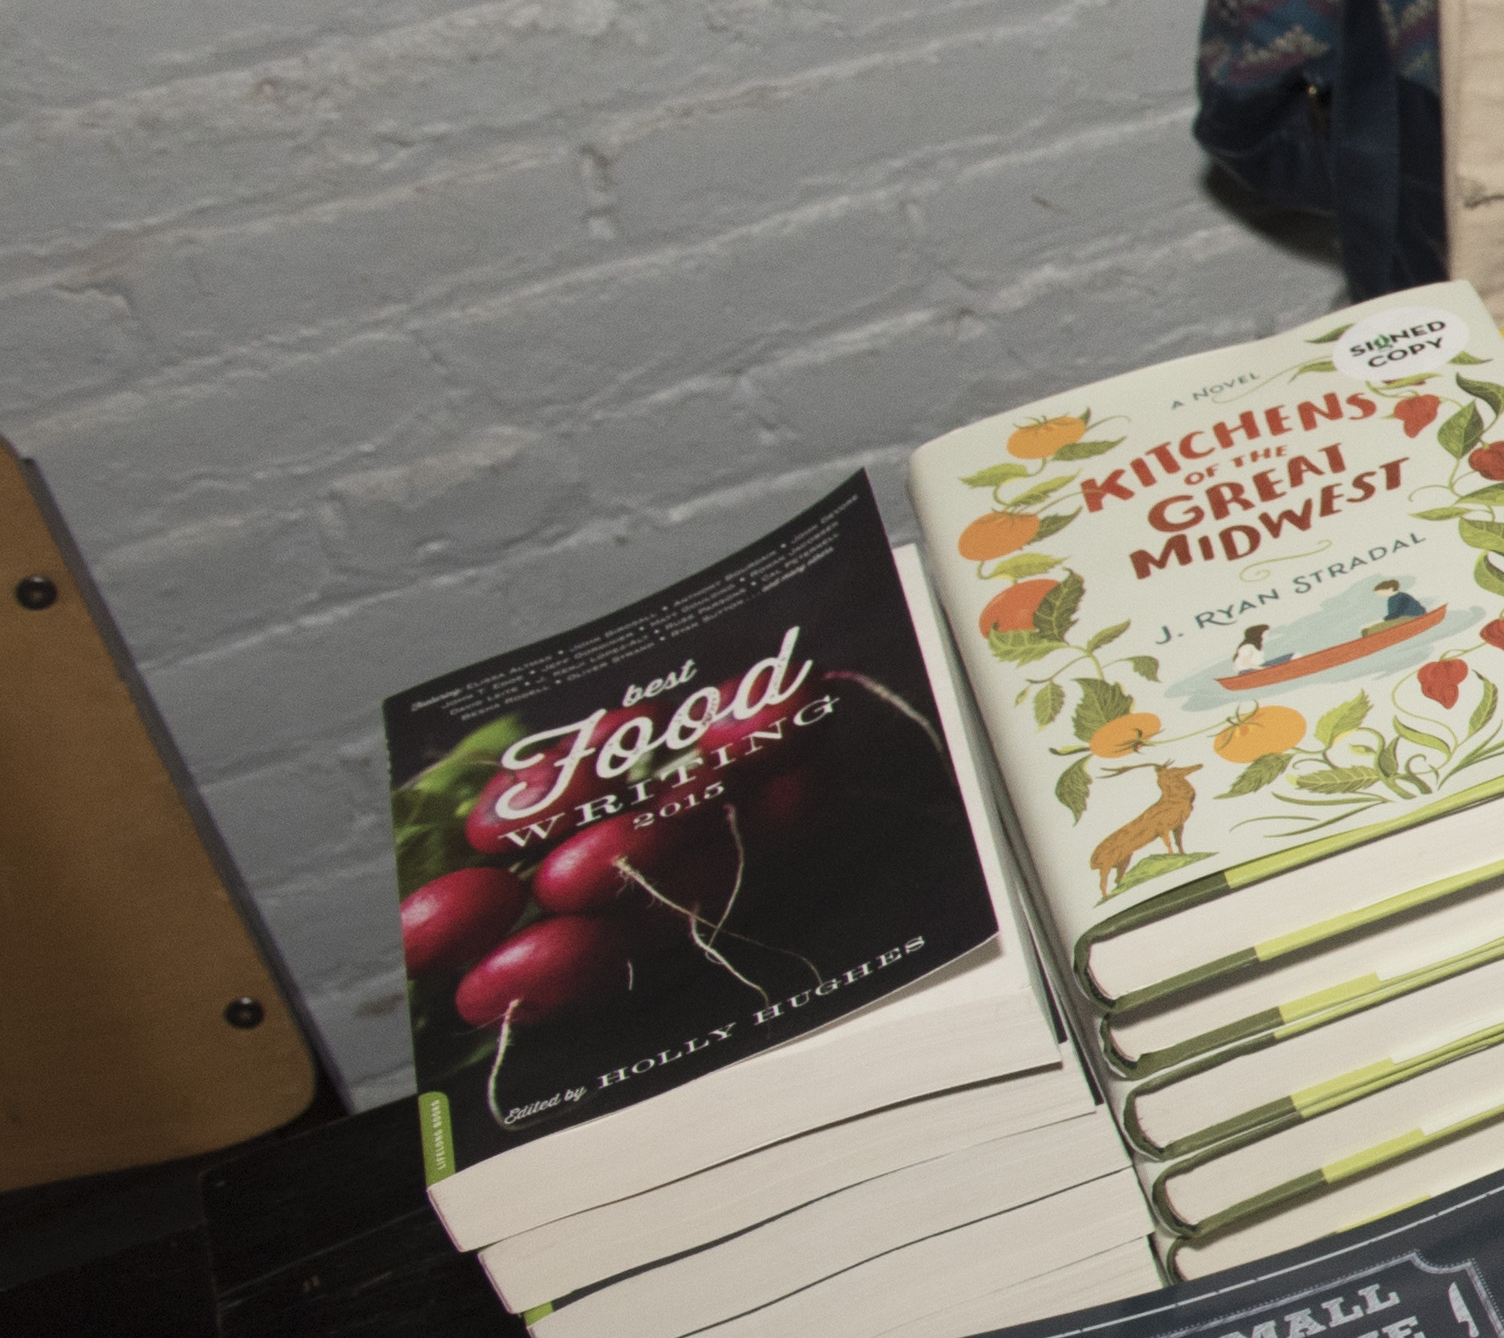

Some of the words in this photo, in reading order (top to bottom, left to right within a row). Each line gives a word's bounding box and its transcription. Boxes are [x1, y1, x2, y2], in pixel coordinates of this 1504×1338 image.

[1349, 317, 1447, 358] SIGNED
[1365, 335, 1447, 370] COPY
[1170, 398, 1183, 410] A
[1192, 370, 1261, 404] NOVEL
[1079, 389, 1378, 513] KITCHENS
[1146, 444, 1347, 533] GREAT
[1185, 464, 1227, 487] OF
[1233, 445, 1289, 468] THE
[1129, 458, 1410, 581] MIDWEST
[1153, 623, 1183, 646] J.
[1195, 590, 1281, 632] RYAN
[1292, 532, 1426, 596] STRADAL
[495, 626, 813, 820] Food
[622, 659, 697, 707] best
[499, 696, 841, 850] WRITING
[633, 782, 725, 830] 2015
[503, 1100, 558, 1126] Edited
[564, 1085, 585, 1104] by
[598, 1024, 737, 1089] HOLLY
[754, 936, 927, 1025] HUGHES
